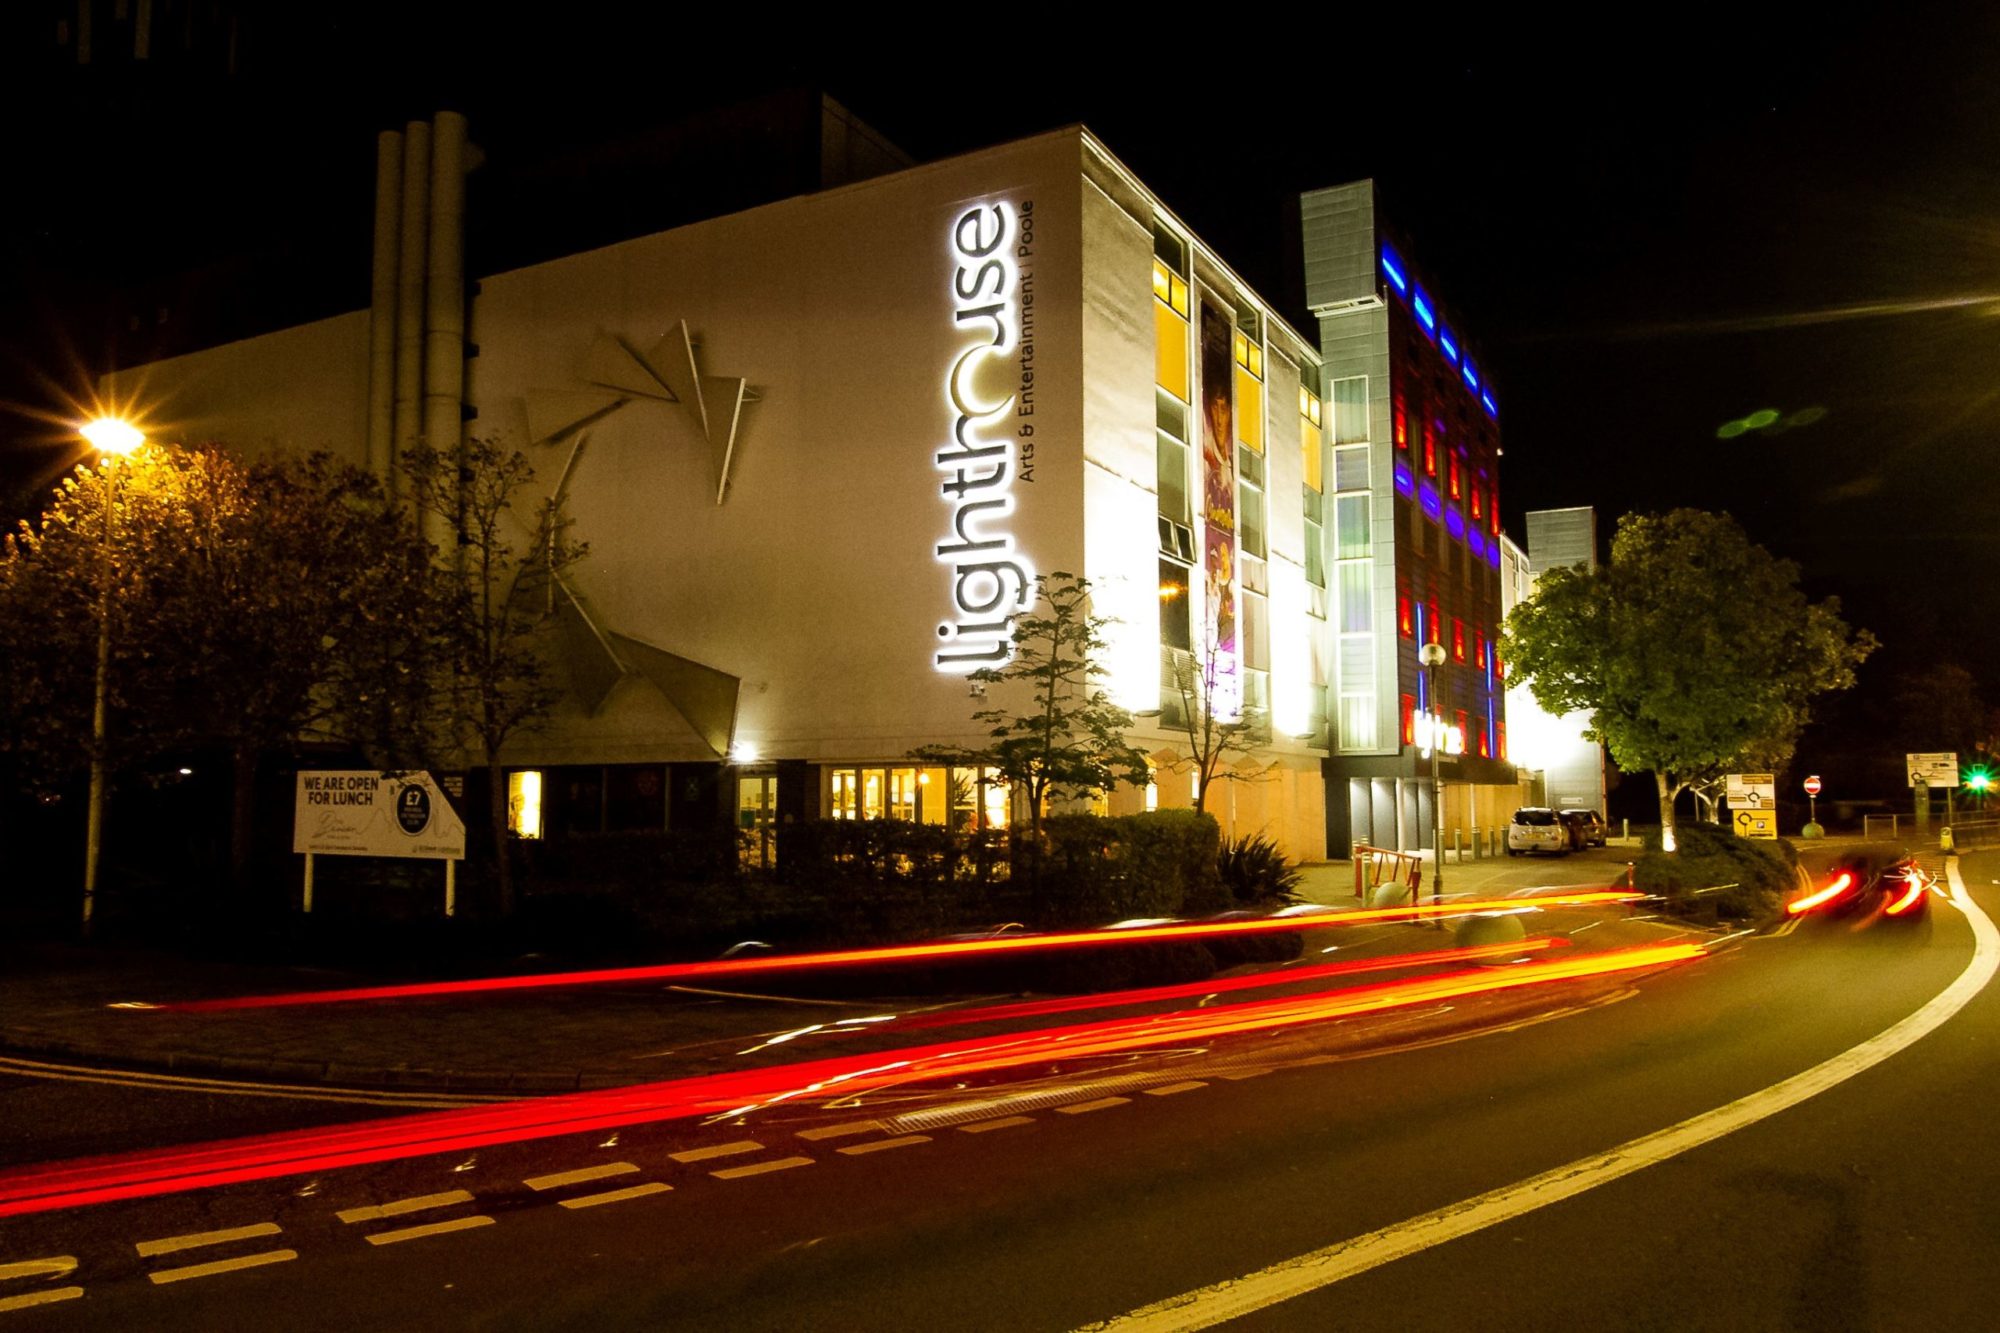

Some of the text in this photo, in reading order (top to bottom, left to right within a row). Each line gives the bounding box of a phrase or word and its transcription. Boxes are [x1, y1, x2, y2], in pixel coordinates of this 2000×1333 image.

[1018, 200, 1034, 483] Arts & Entertainment Poole
[304, 777, 379, 791] WE ARE OPEN
[308, 792, 373, 806] FOR LUNCH
